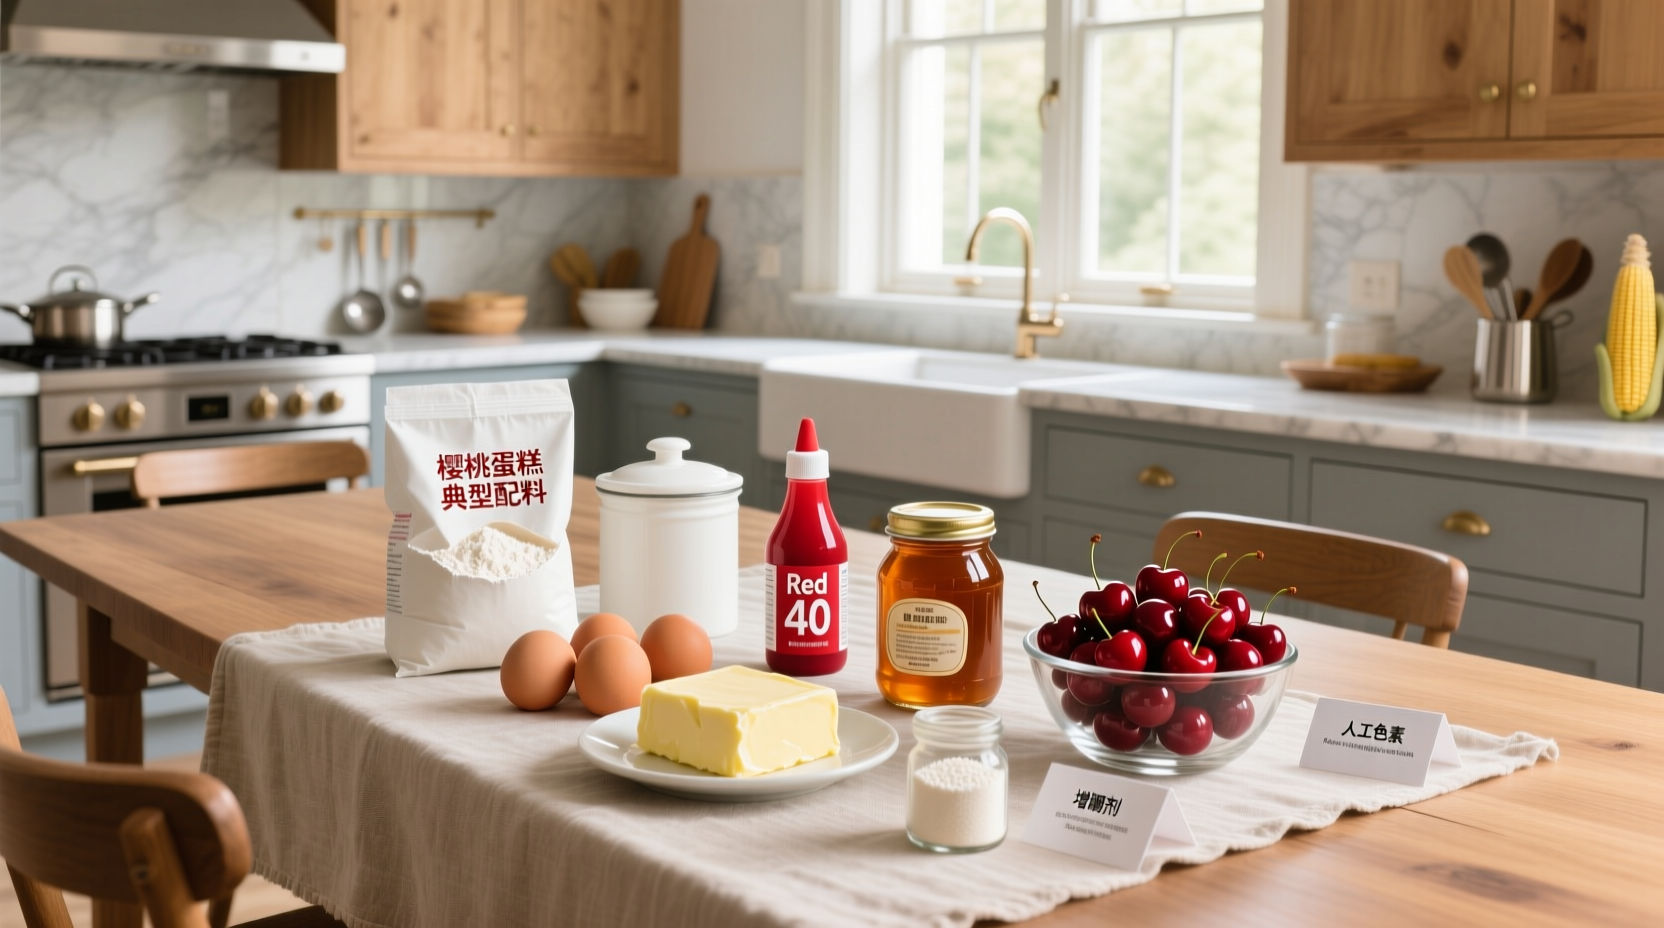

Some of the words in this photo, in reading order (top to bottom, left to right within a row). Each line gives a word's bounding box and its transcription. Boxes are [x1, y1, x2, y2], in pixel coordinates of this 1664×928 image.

[437, 449, 544, 481] 樱桃蛋糕
[441, 479, 547, 511] 典型配料
[787, 572, 828, 595] Red
[784, 598, 831, 636] 40
[1341, 720, 1405, 744] 人工色素
